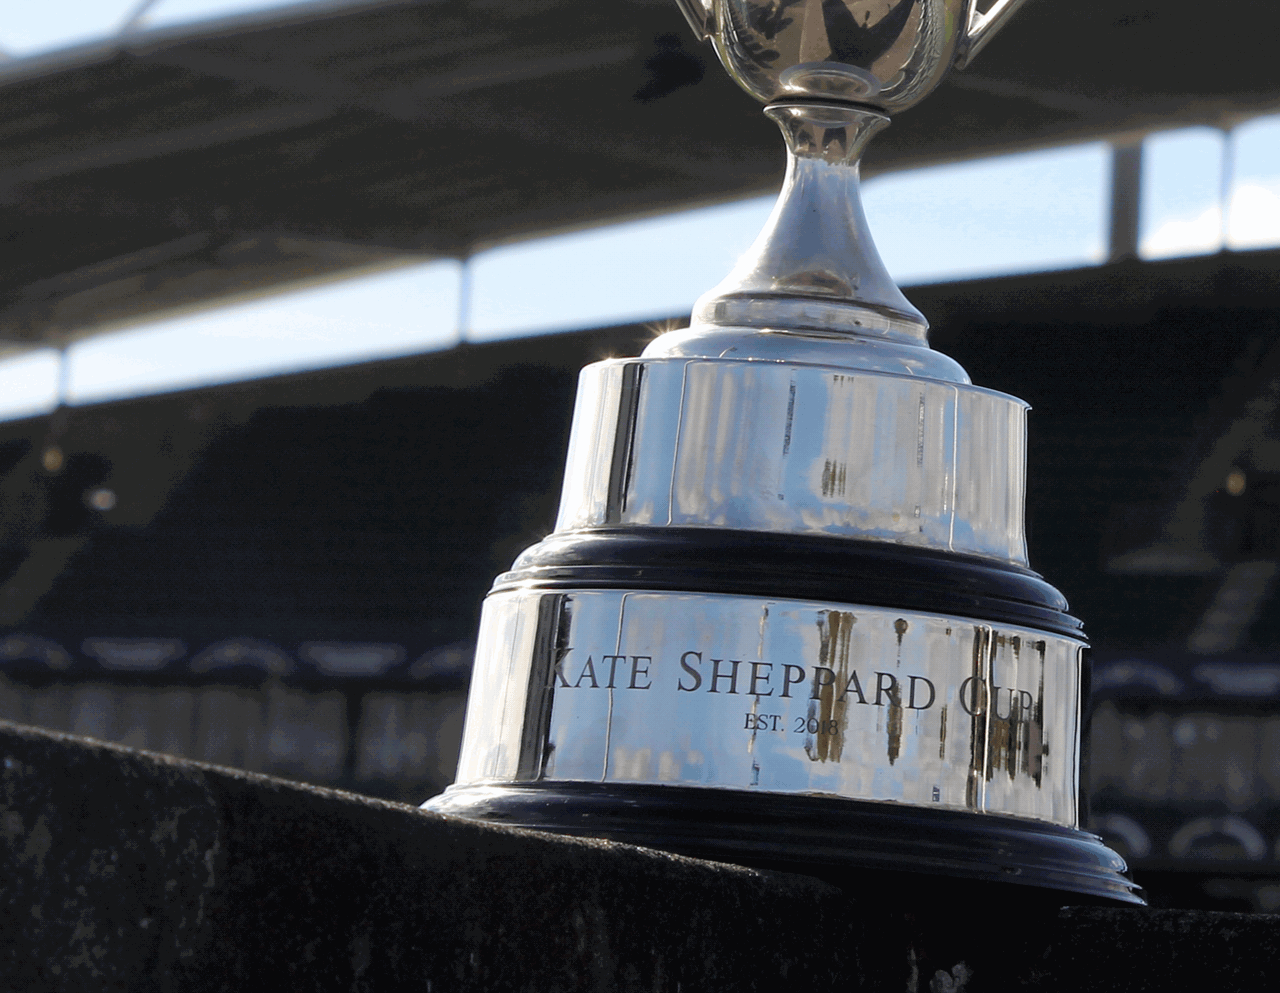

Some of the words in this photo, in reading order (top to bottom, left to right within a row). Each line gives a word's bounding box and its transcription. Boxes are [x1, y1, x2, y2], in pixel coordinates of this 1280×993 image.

[546, 647, 653, 690] KATE
[677, 651, 937, 711] SHEPPARD
[959, 676, 1033, 723] CUP
[744, 713, 784, 732] EST.
[793, 717, 839, 736] 2018
